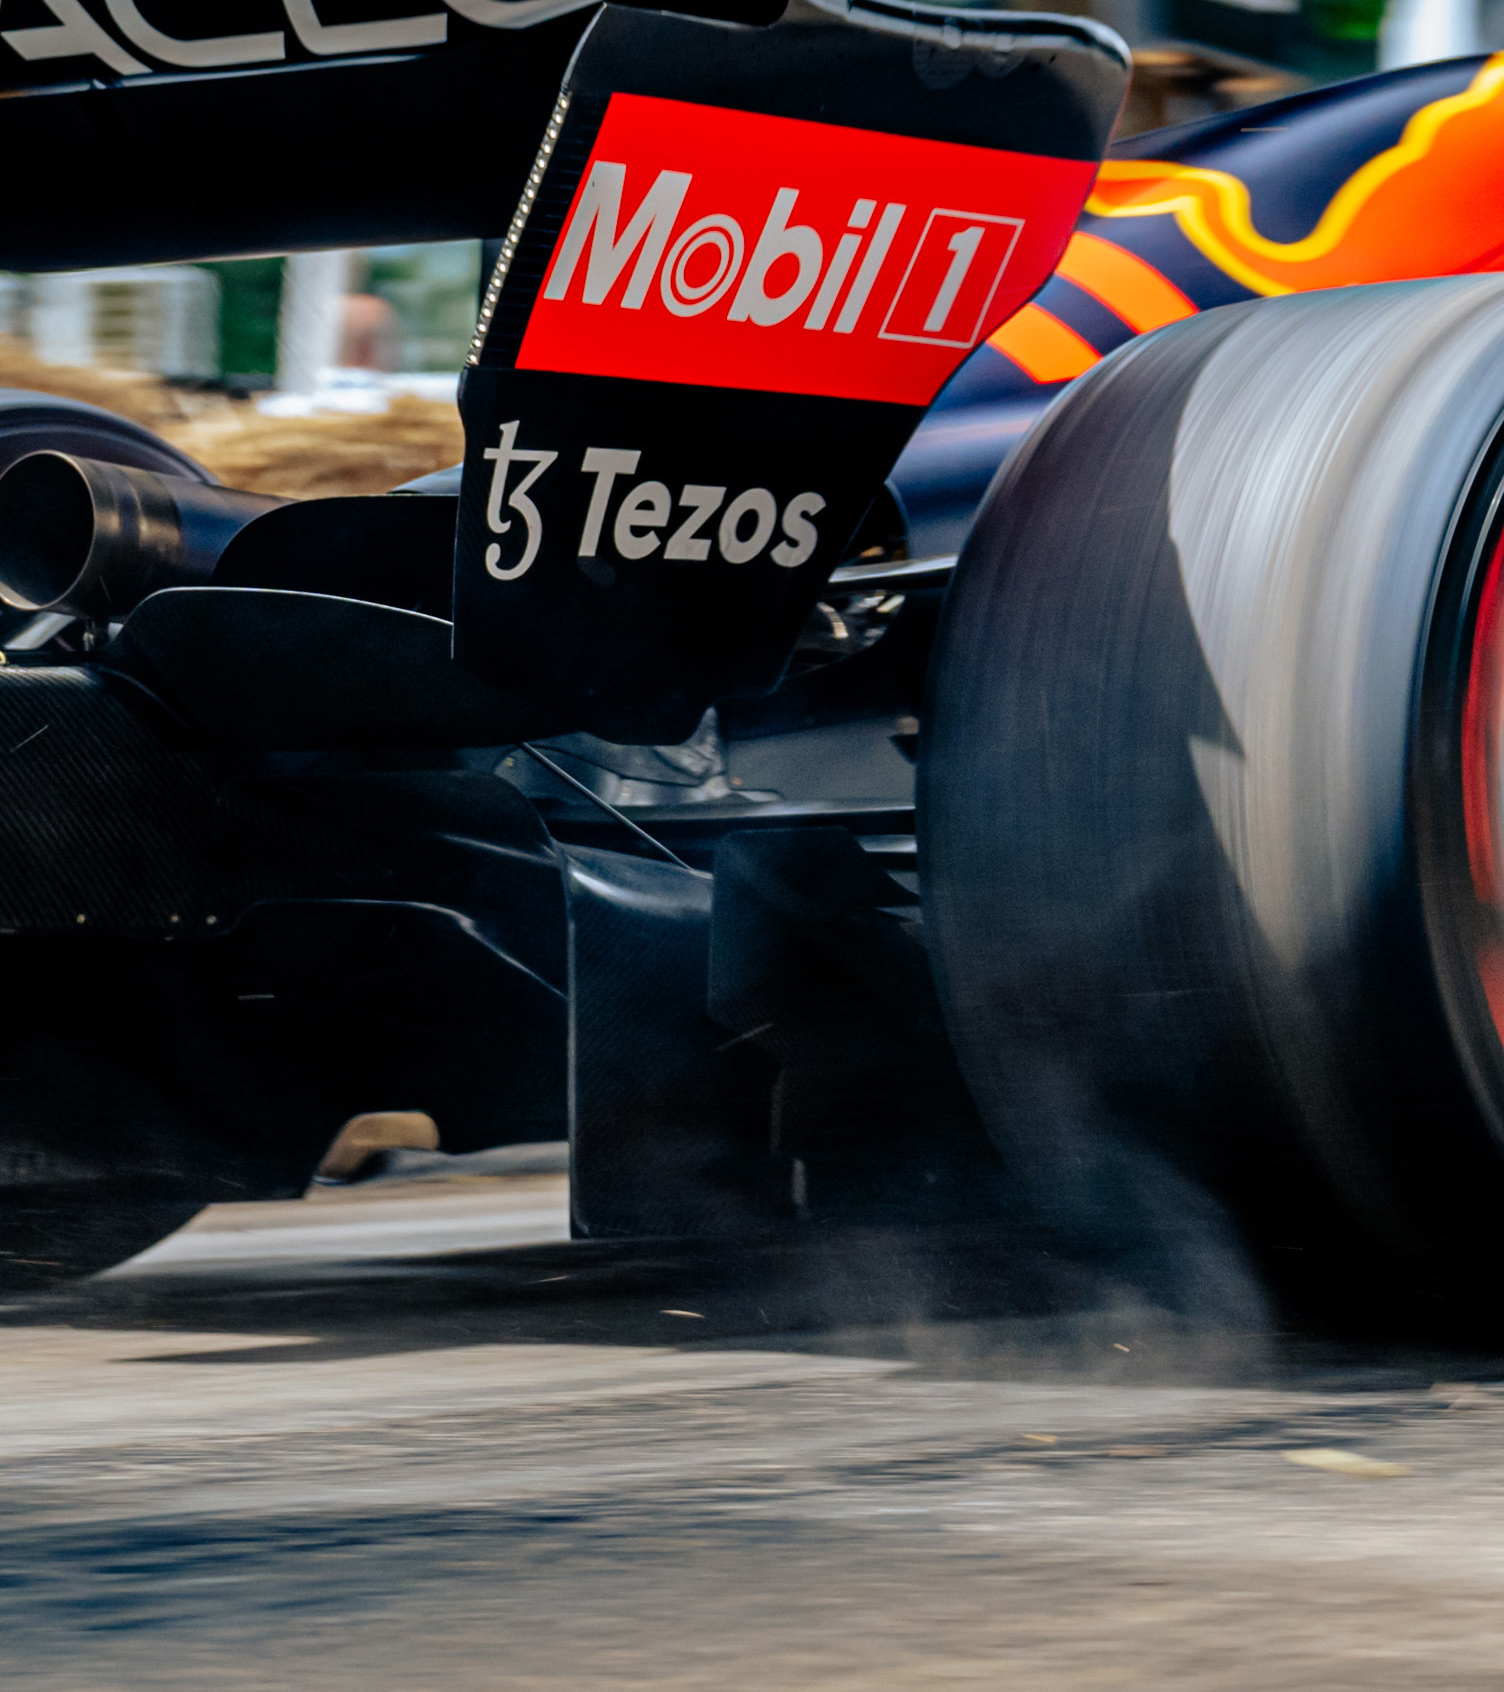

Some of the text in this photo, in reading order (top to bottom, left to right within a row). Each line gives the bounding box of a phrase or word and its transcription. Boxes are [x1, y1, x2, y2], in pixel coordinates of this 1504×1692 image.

[543, 160, 985, 333] Mobil 1
[578, 447, 825, 568] Tezos
